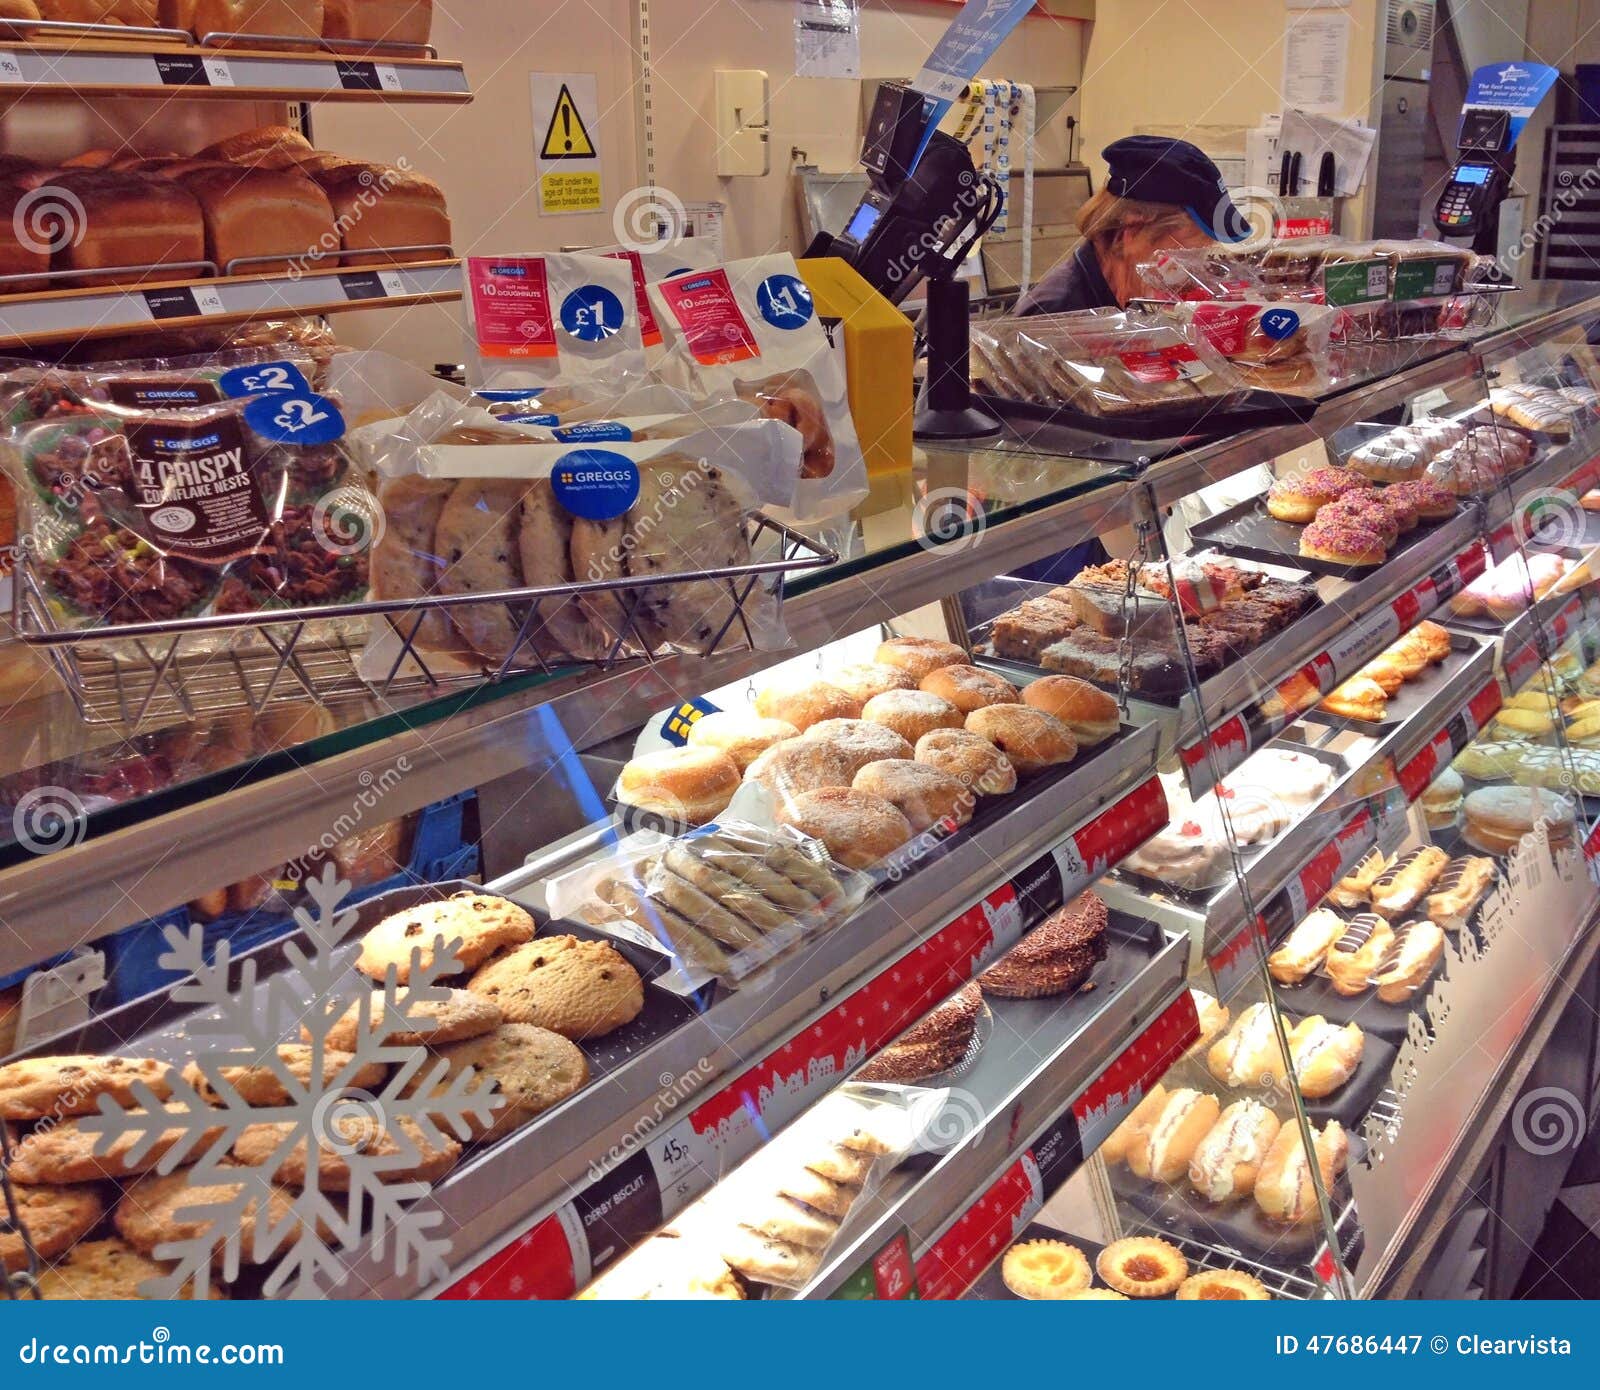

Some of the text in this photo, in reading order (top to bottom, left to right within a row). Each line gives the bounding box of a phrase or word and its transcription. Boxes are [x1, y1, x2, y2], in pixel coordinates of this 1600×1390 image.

[582, 175, 593, 185] the
[497, 267, 525, 276] GREGGS
[479, 283, 497, 296] 10
[687, 279, 712, 290] GREGGS
[497, 289, 542, 298] DOUGHNUTS
[677, 298, 694, 311] 10
[575, 300, 604, 326] £1
[1267, 314, 1292, 331] £1
[509, 347, 529, 355] NEW
[242, 367, 295, 391] £2
[147, 391, 197, 399] GREGGS
[273, 399, 329, 433] £2
[572, 425, 622, 434] GREGGS
[166, 435, 220, 450] GREGGS
[139, 447, 243, 489] 4 CRISPY
[575, 470, 632, 483] GREGGS
[143, 472, 250, 504] CORNFLAKE NESTS
[662, 1137, 689, 1165] 45p
[583, 1174, 647, 1226] DERBY BISCUIT
